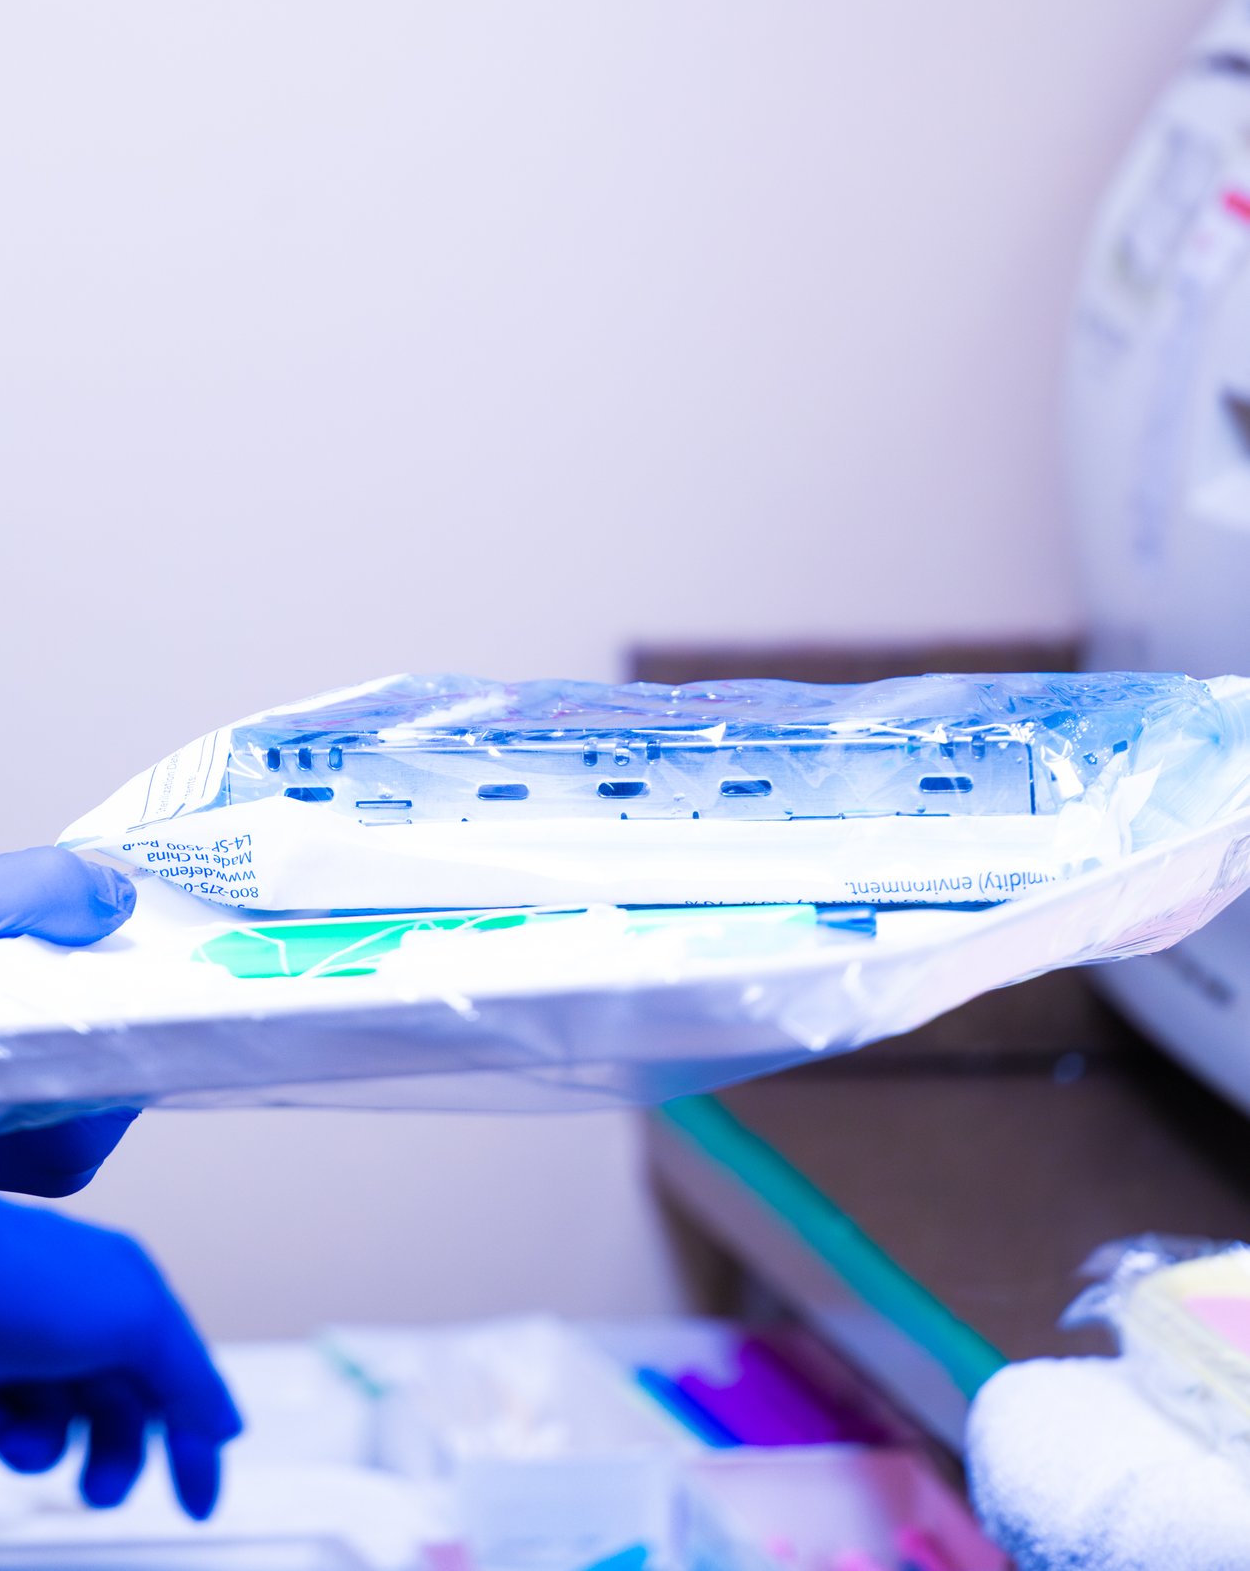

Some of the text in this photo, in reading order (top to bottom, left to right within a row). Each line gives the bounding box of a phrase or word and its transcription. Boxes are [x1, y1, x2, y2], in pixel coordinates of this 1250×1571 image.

[147, 850, 252, 868] Made in China
[176, 882, 259, 898] 800-275-0
[845, 871, 1056, 895] midity) environment.
